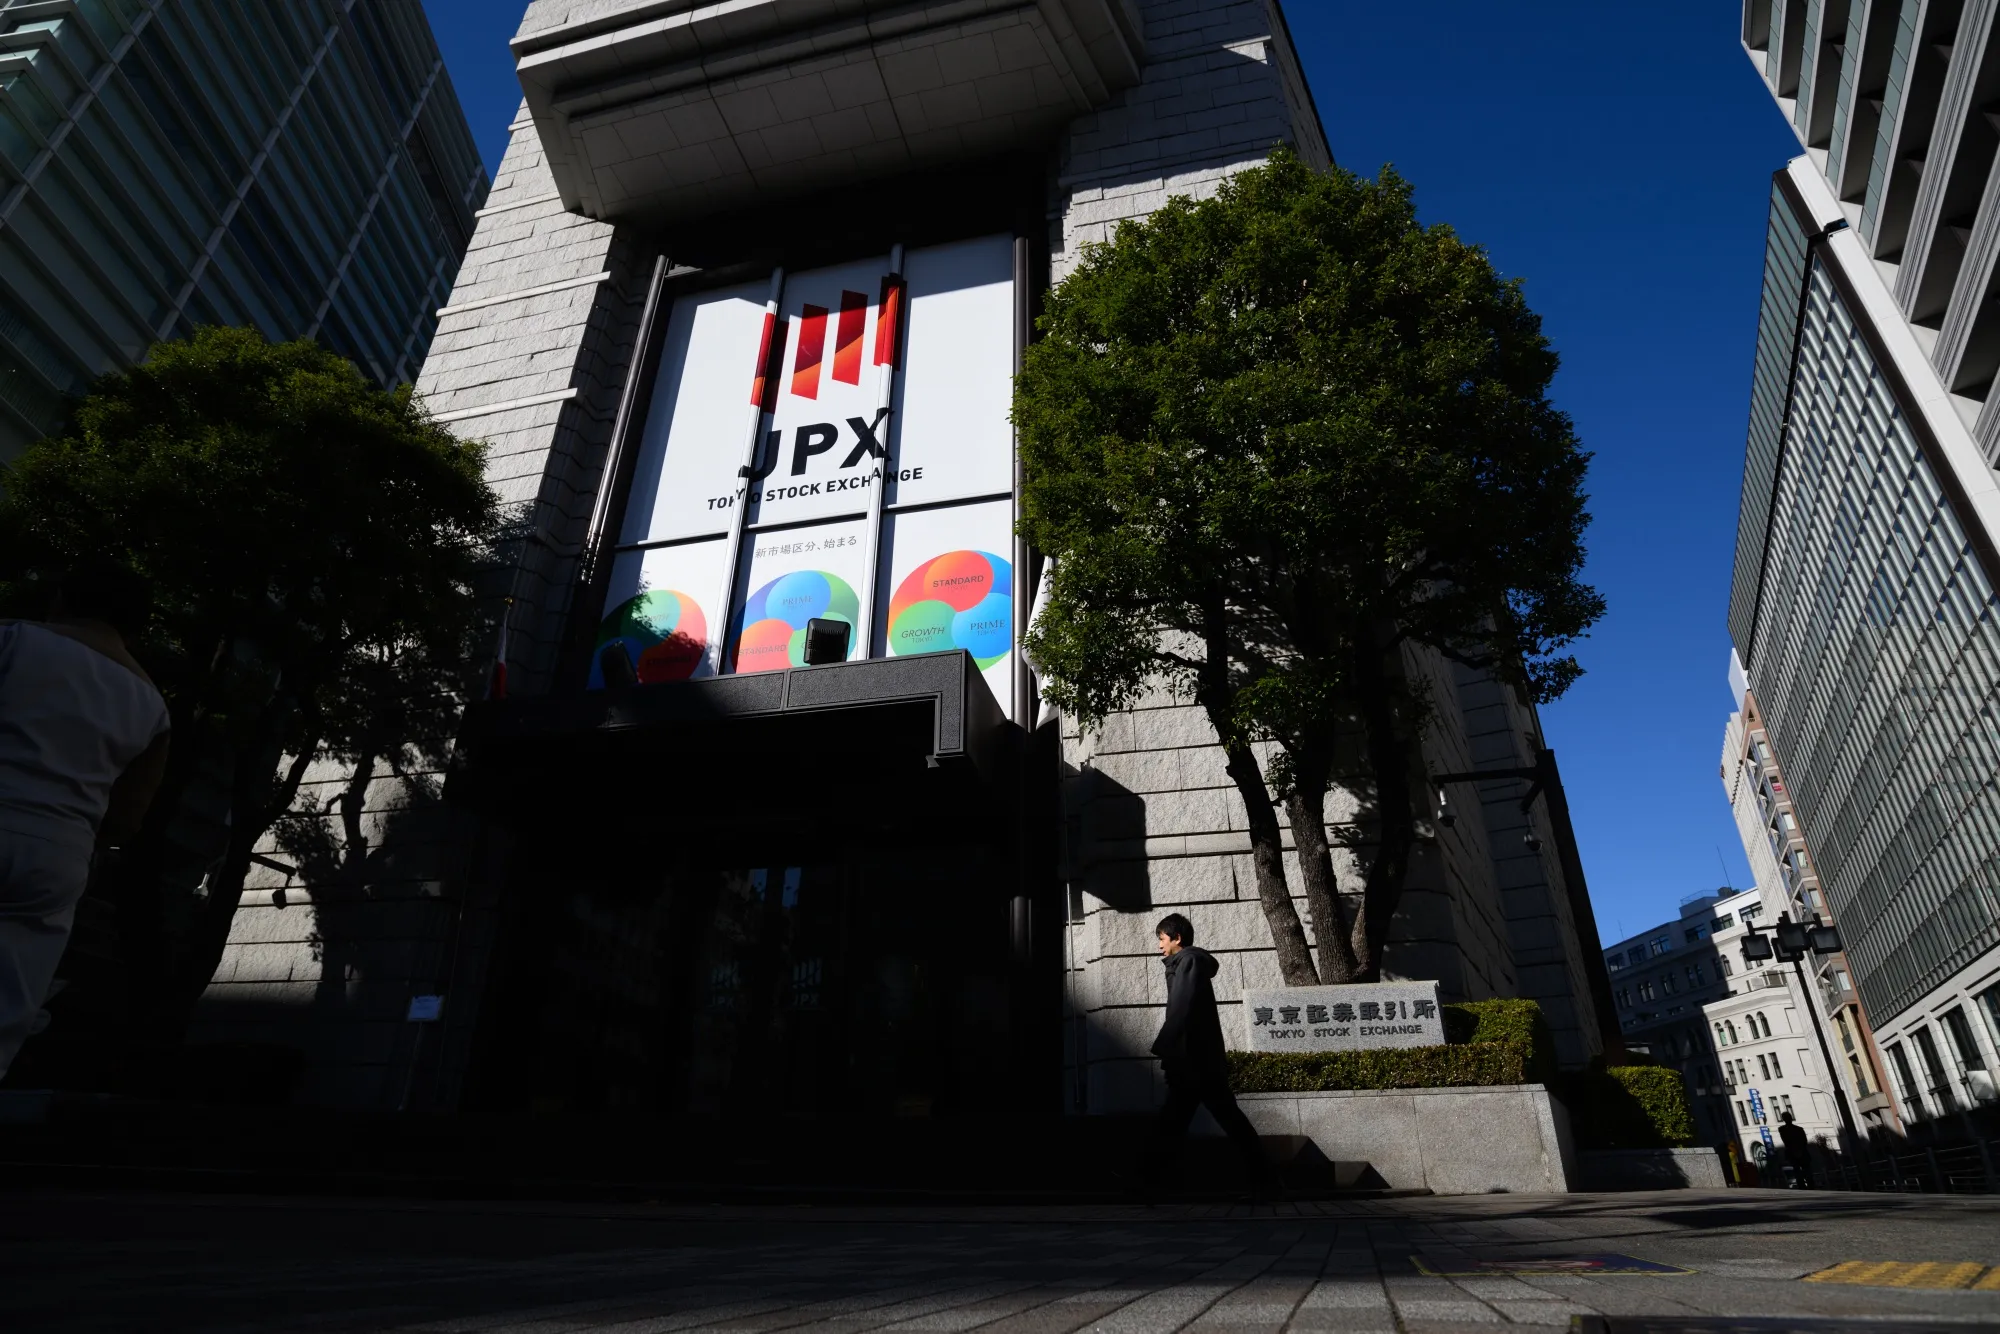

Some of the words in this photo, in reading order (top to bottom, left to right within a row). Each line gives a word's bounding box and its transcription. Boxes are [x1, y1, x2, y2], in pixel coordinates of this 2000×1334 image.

[738, 407, 895, 483] JPX
[766, 483, 820, 502] STOCK
[826, 467, 923, 493] EXCHANGE
[755, 536, 857, 558] 新市場区分、始まる
[933, 575, 984, 588] STANDARD
[782, 595, 813, 605] PRIME
[970, 619, 1006, 631] PRIME
[901, 626, 945, 639] GROWTH
[739, 644, 787, 656] STANDARD
[1254, 999, 1436, 1026] 東京証券取引所
[1269, 1029, 1305, 1039] TOKYO
[1314, 1027, 1350, 1038] STOCK
[1360, 1024, 1423, 1036] EXCHANGE
